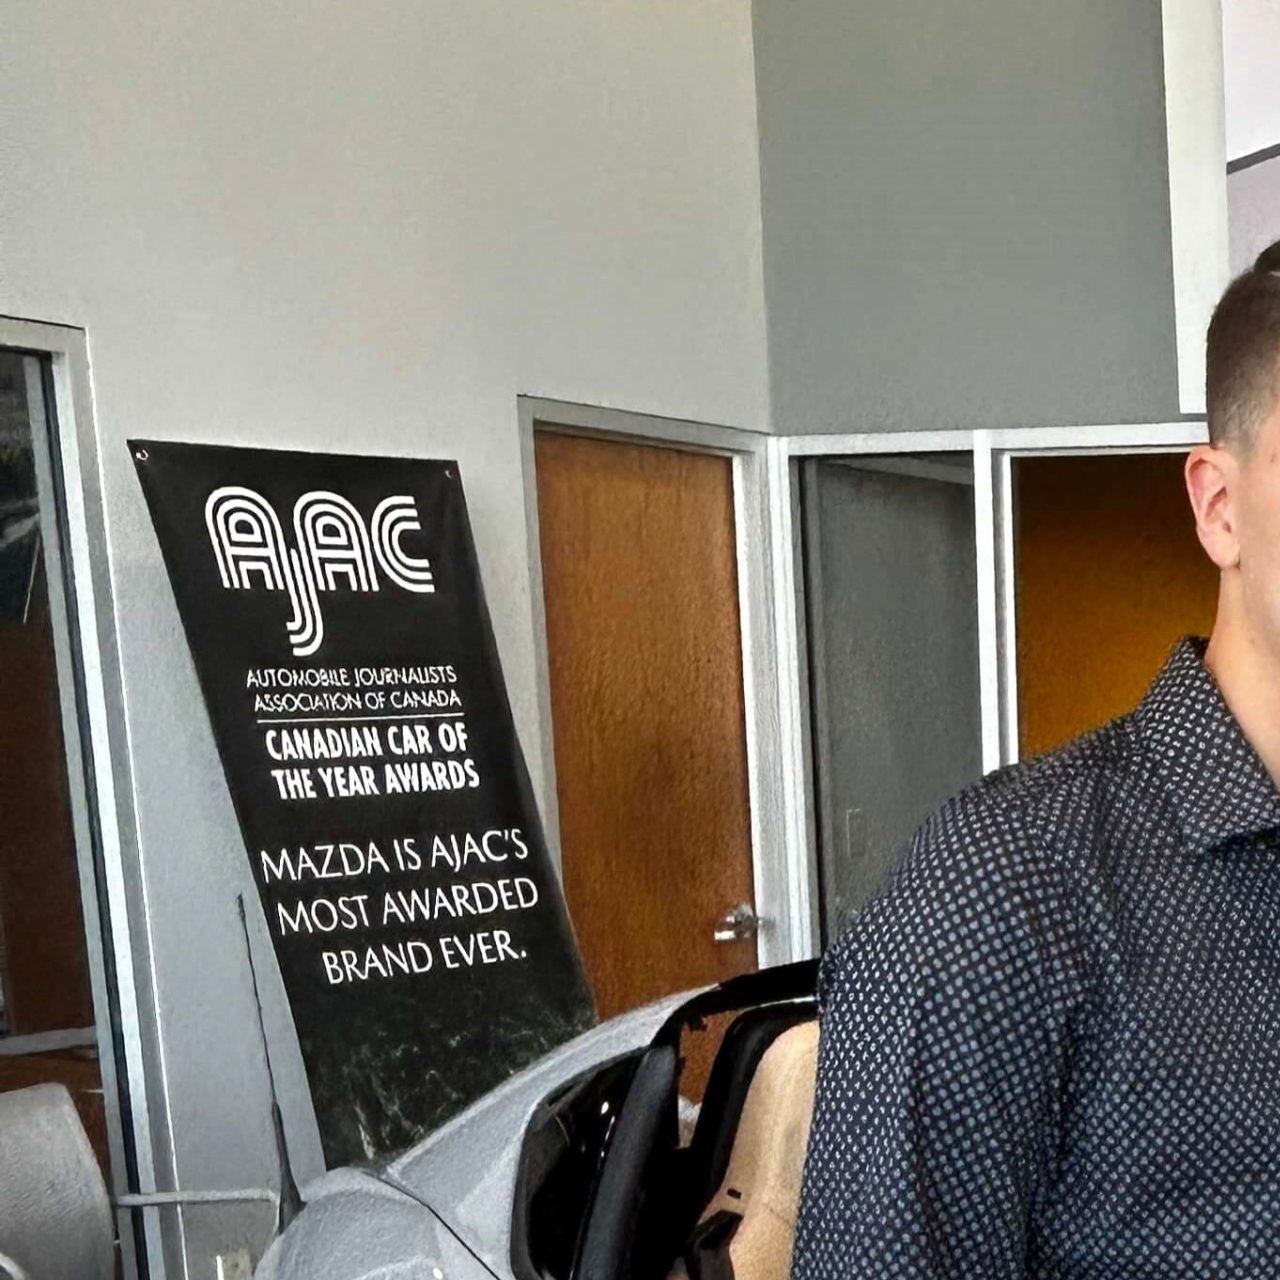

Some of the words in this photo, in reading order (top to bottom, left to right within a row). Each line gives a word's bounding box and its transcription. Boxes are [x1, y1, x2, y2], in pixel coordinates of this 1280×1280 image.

[205, 486, 435, 657] AJAC
[247, 668, 351, 688] AUTOMOBILE
[355, 666, 458, 687] JOURNALISTS
[254, 692, 362, 712] ASSOCIATION
[365, 691, 386, 710] OF
[391, 689, 462, 709] CANADA
[265, 726, 383, 760] CANADIAN
[388, 725, 433, 754] CAR
[438, 722, 468, 752] OF
[271, 768, 317, 800] THE
[318, 765, 381, 798] YEAR
[384, 758, 480, 795] AWARDS
[261, 842, 390, 883] MAZDA
[393, 838, 421, 872] IS
[431, 829, 528, 873] AJAC'S
[277, 895, 370, 936] MOST
[383, 877, 539, 925] AWARDED
[322, 941, 433, 985] BRAND
[439, 930, 527, 969] EVER.
